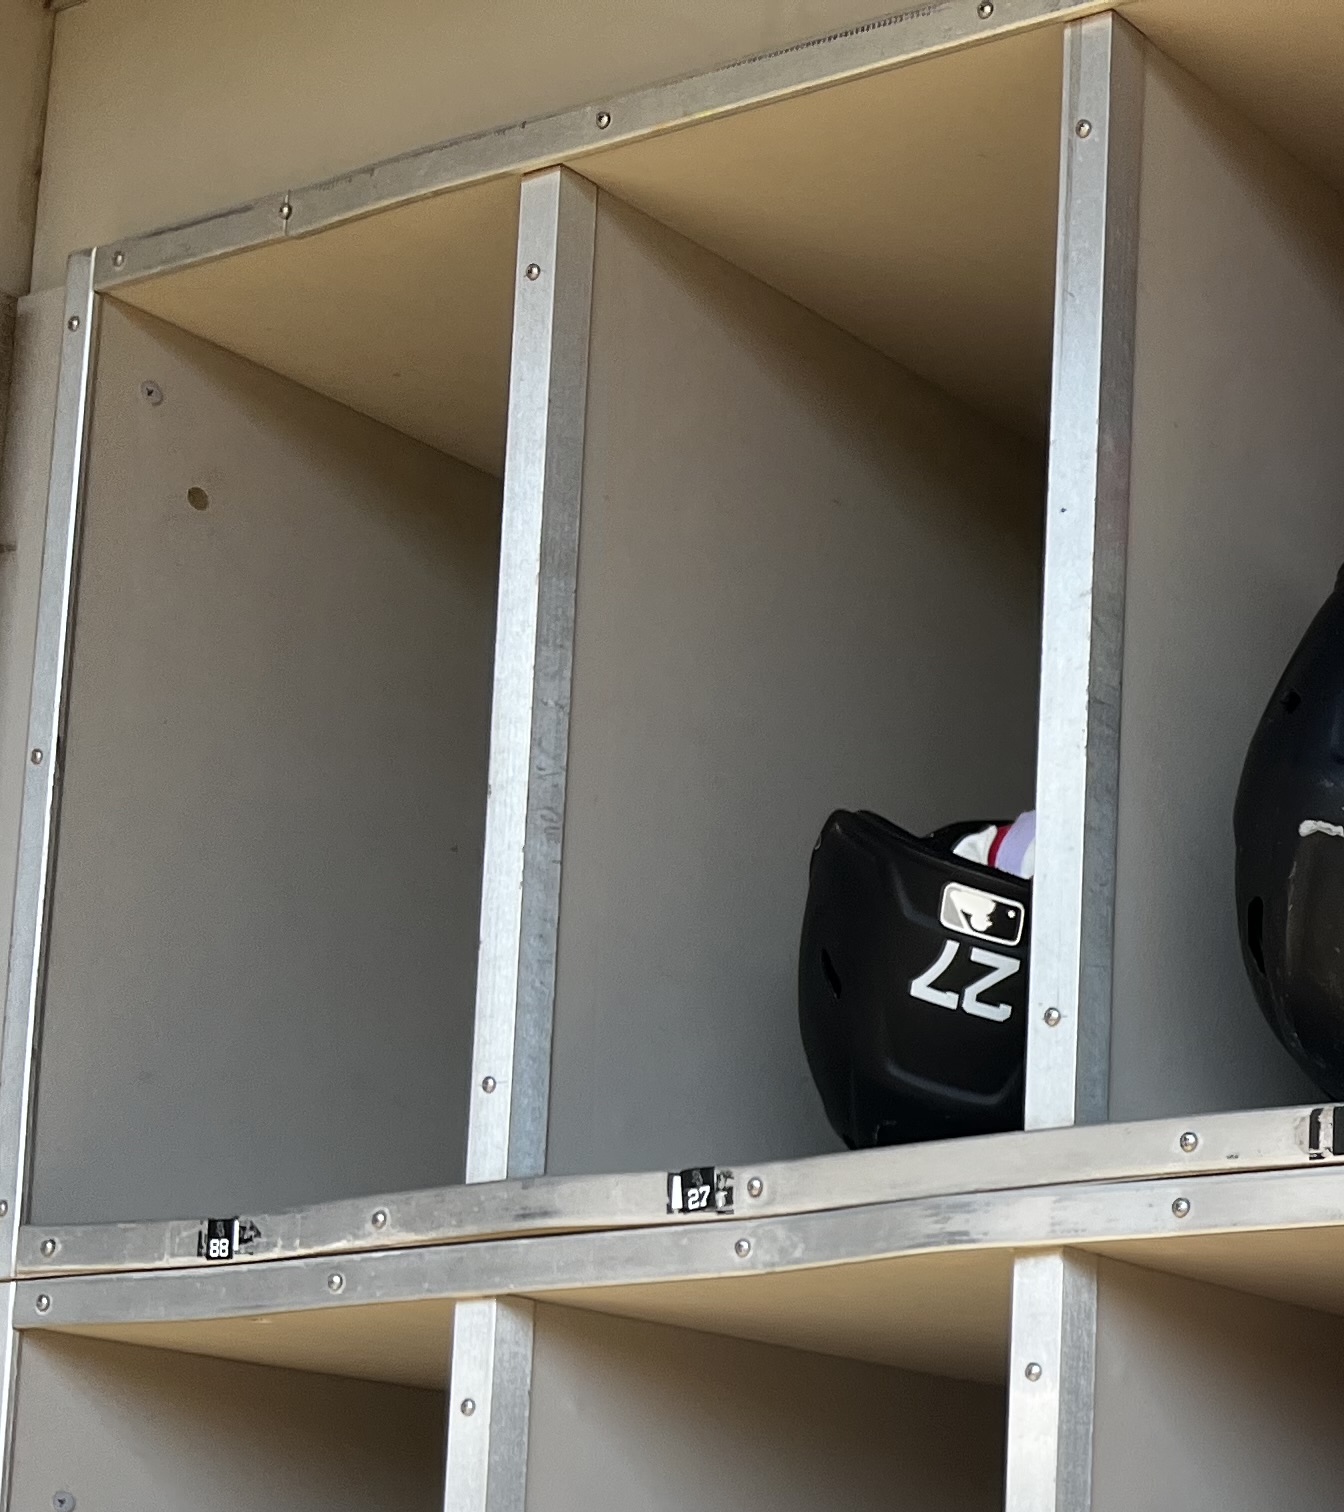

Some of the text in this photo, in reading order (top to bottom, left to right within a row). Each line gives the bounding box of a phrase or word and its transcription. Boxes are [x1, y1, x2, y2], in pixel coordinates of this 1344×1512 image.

[909, 940, 1021, 1022] 27
[687, 1185, 711, 1211] 27
[209, 1238, 229, 1258] 88
